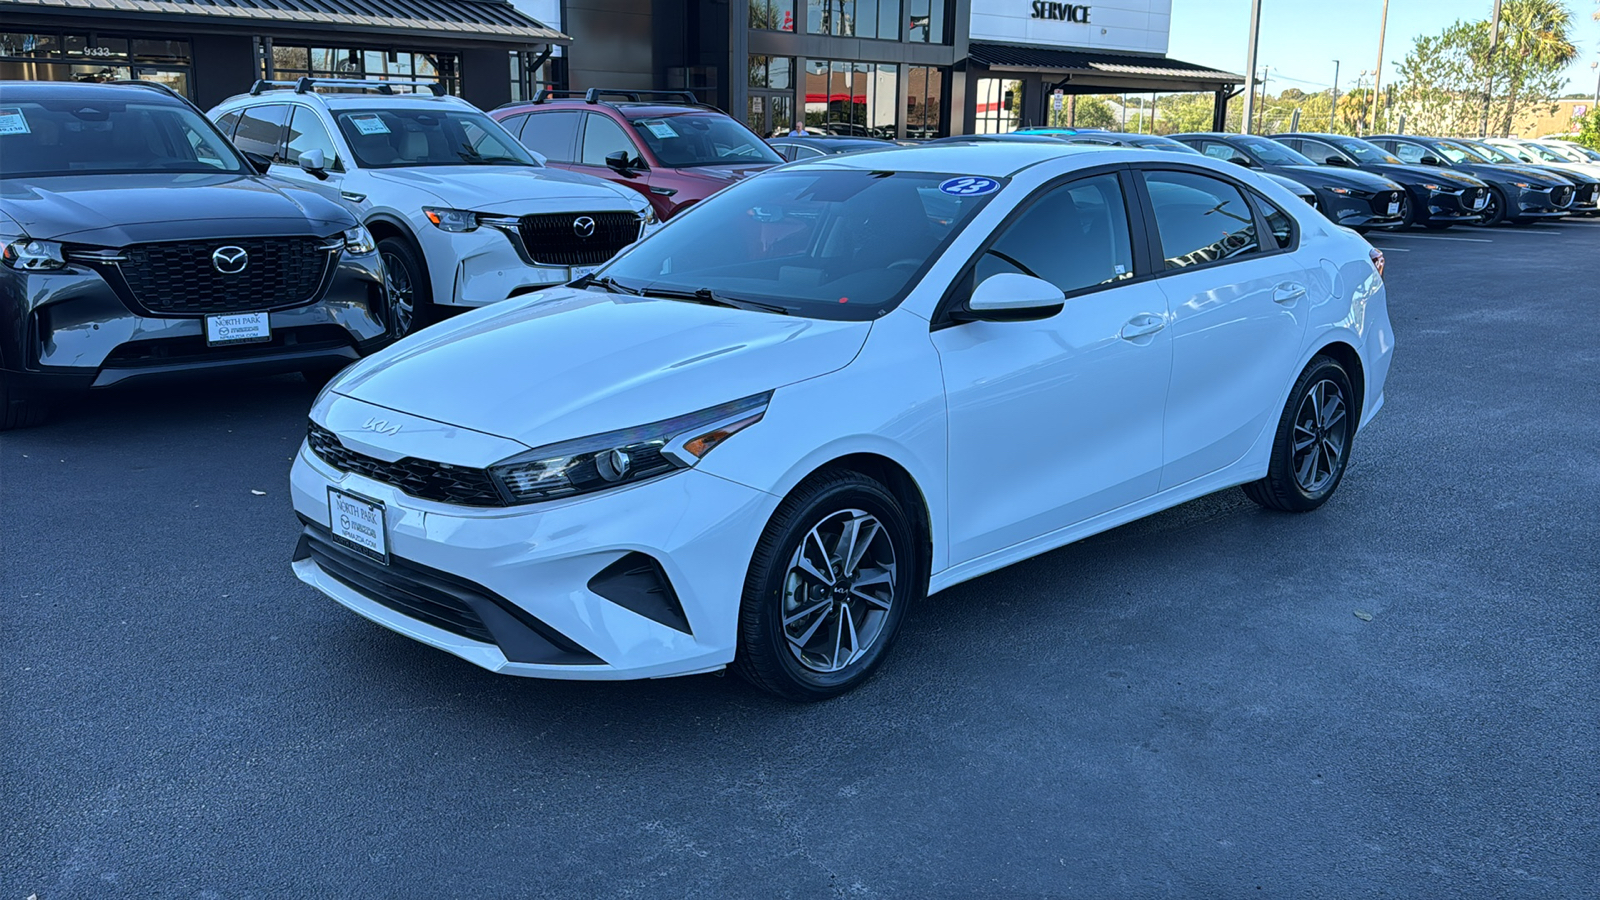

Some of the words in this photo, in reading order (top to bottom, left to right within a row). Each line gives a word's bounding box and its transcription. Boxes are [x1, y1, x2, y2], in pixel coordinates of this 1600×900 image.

[1031, 0, 1091, 23] SERVICE
[83, 46, 110, 56] 9333
[946, 179, 990, 193] 23
[215, 317, 241, 327] NORTH
[242, 316, 261, 325] PARK
[336, 499, 360, 517] NORTH
[360, 508, 378, 525] PARK
[341, 529, 377, 549] NPMAZDA.COM
